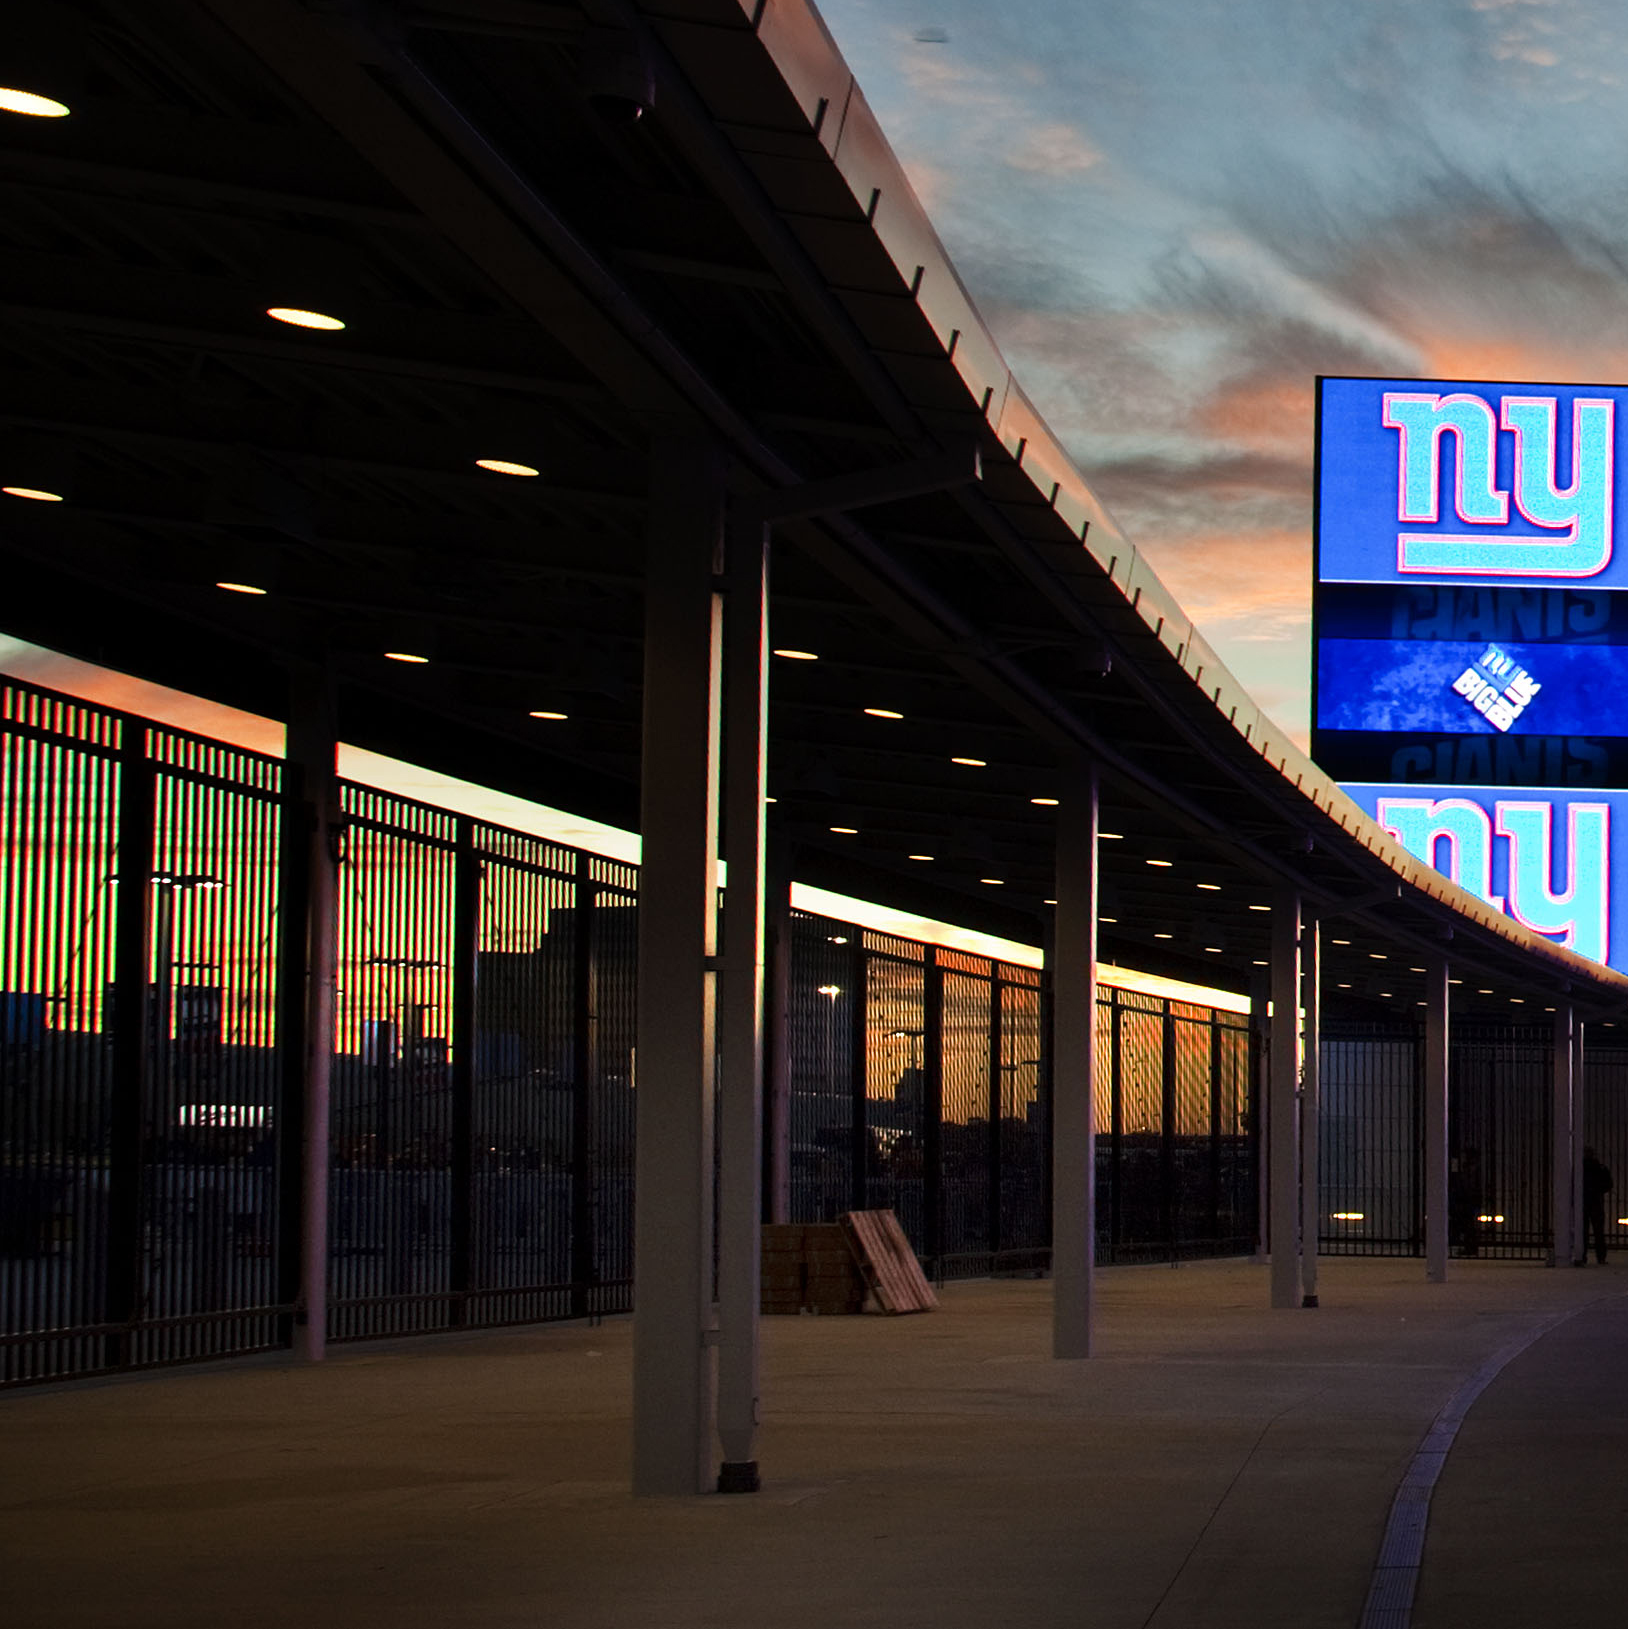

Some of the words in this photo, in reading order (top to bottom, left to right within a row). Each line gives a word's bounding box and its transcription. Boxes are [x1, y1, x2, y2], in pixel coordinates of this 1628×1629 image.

[1383, 393, 1614, 578] ny
[1452, 667, 1500, 714] BIG
[1484, 670, 1542, 733] BLUE
